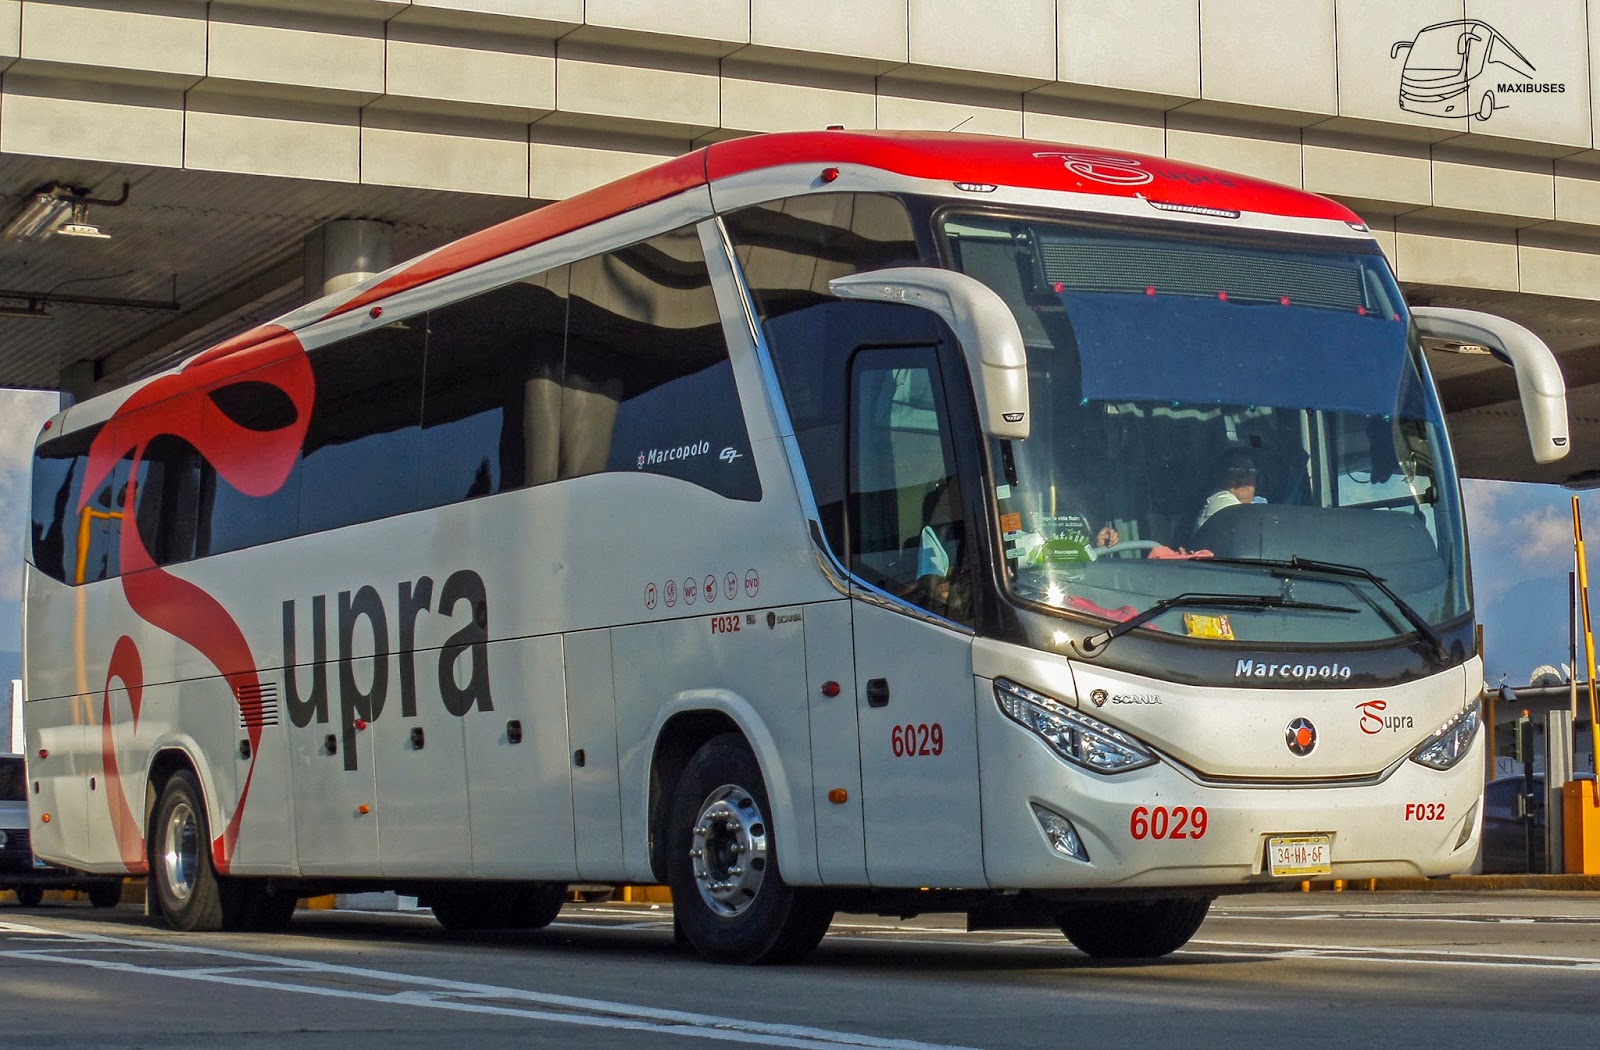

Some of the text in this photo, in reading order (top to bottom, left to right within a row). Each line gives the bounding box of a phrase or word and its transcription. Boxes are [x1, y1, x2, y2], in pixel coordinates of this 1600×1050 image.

[647, 440, 710, 465] Marcopolo
[685, 586, 696, 597] WC
[746, 578, 758, 588] DVD
[711, 615, 740, 634] F032
[777, 613, 802, 623] SCANIA
[1235, 659, 1352, 680] Marcopolo
[1112, 694, 1162, 705] SCANIA
[1355, 700, 1413, 735] Supra
[892, 723, 943, 757] 6029
[1405, 803, 1446, 821] F032
[1131, 806, 1208, 840] 6029
[1278, 846, 1323, 863] 34-HA-6F
